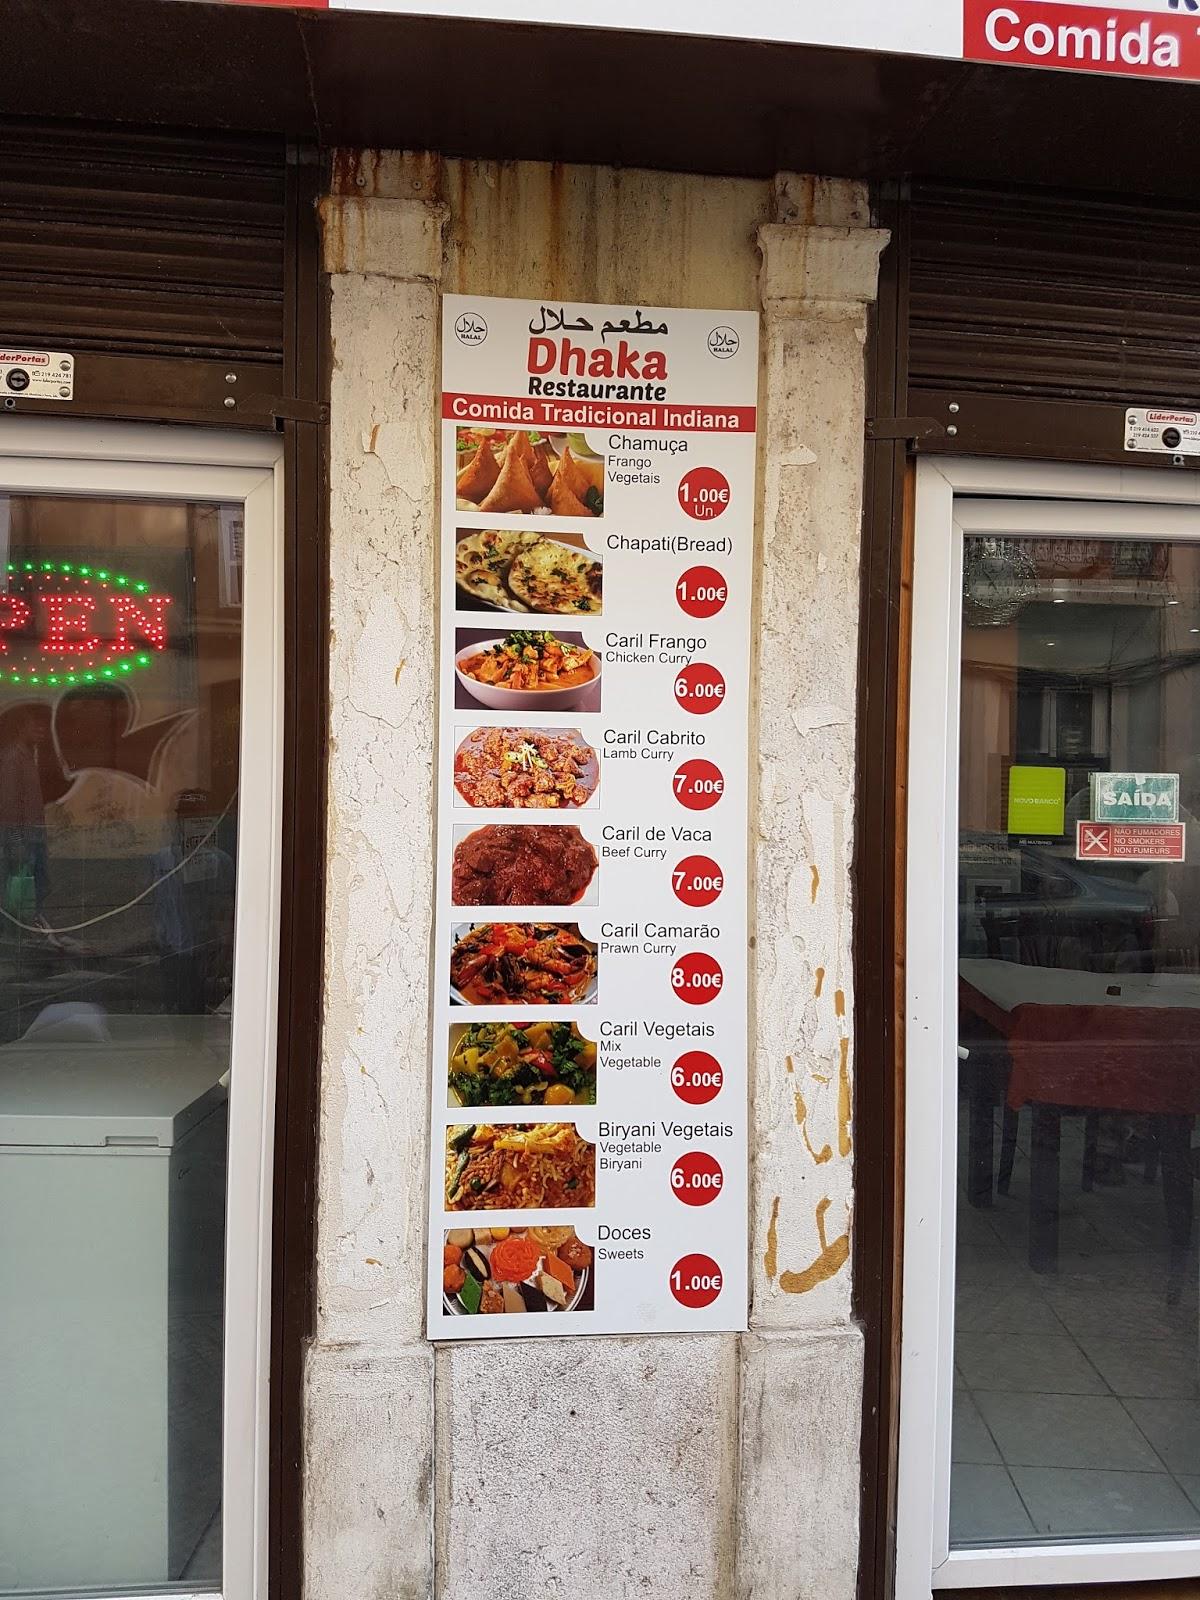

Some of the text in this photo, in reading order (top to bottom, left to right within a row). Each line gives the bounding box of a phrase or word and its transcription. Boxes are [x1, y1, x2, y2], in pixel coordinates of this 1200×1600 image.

[985, 9, 1179, 67] Comida
[528, 305, 668, 344] مطعم حلال
[527, 337, 668, 381] Dhaka
[528, 376, 667, 401] Restaurante
[452, 397, 740, 428] Comida Tradicional Indiana
[608, 434, 689, 456] Chamuça
[607, 455, 652, 471] Frango
[607, 471, 661, 486] Vegetais
[680, 482, 729, 503] 1.00€
[694, 504, 718, 517] Un.
[607, 534, 733, 555] Chapati(Bread)
[677, 581, 726, 602] 1.00€
[605, 632, 707, 652] Caril Frango
[605, 651, 692, 667] Chicken Curry
[674, 678, 724, 698] 6.00€
[603, 729, 706, 745] Caril Cabrito
[603, 747, 674, 762] Lamb Curry
[674, 774, 723, 794] 7.00€
[1103, 789, 1173, 807] SAÍDA
[602, 825, 712, 842] Caril de Vaca
[1113, 837, 1166, 845] NO SMOKERS
[1132, 828, 1181, 837] FUMADORES
[602, 846, 667, 861] Beef Curry
[1113, 846, 1171, 855] NON FUMEURS
[673, 871, 723, 891] 7.00€
[600, 922, 720, 939] Caril Camarão
[600, 942, 677, 957] Prawn Curry
[671, 967, 722, 988] 8.00€
[599, 1021, 715, 1040] Caril Vegetais
[600, 1040, 622, 1052] Mix
[600, 1056, 662, 1070] Vegetable
[671, 1066, 722, 1087] 6.00€
[599, 1122, 734, 1141] Biryani Vegetais
[600, 1142, 662, 1156] Vegetable
[600, 1158, 642, 1172] Biryani
[671, 1168, 722, 1189] 6.00€
[598, 1225, 651, 1240] Doces
[598, 1248, 644, 1260] Sweets
[671, 1270, 721, 1291] 1.00€
